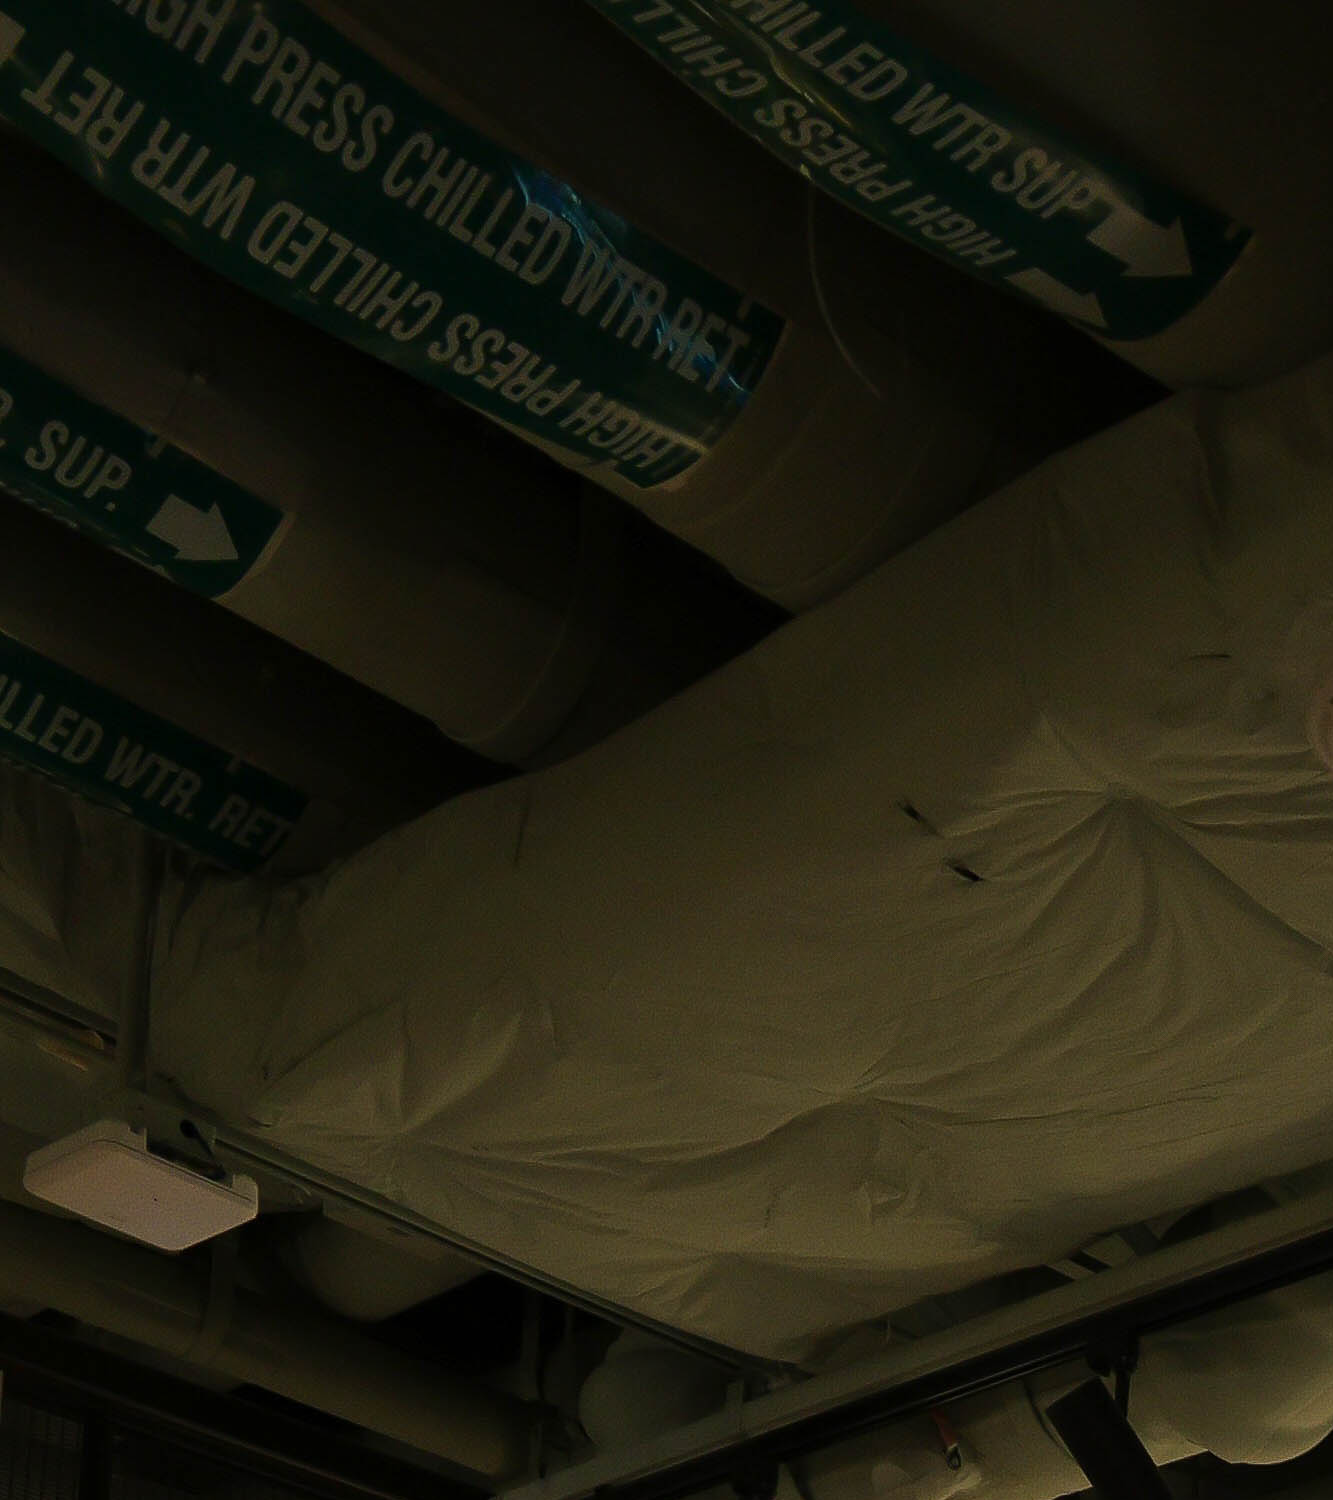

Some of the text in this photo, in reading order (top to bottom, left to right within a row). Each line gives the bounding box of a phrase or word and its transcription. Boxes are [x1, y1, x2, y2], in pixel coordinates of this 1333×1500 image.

[222, 15, 753, 393] PRESS CHILLED WTR RET
[754, 97, 1018, 266] HIGH PRESS
[892, 82, 1097, 220] WTR SUP
[20, 49, 680, 469] HIGH PRESS CHILLED WTR RET
[23, 419, 134, 513] SUP.
[103, 734, 297, 860] WTR. RET
